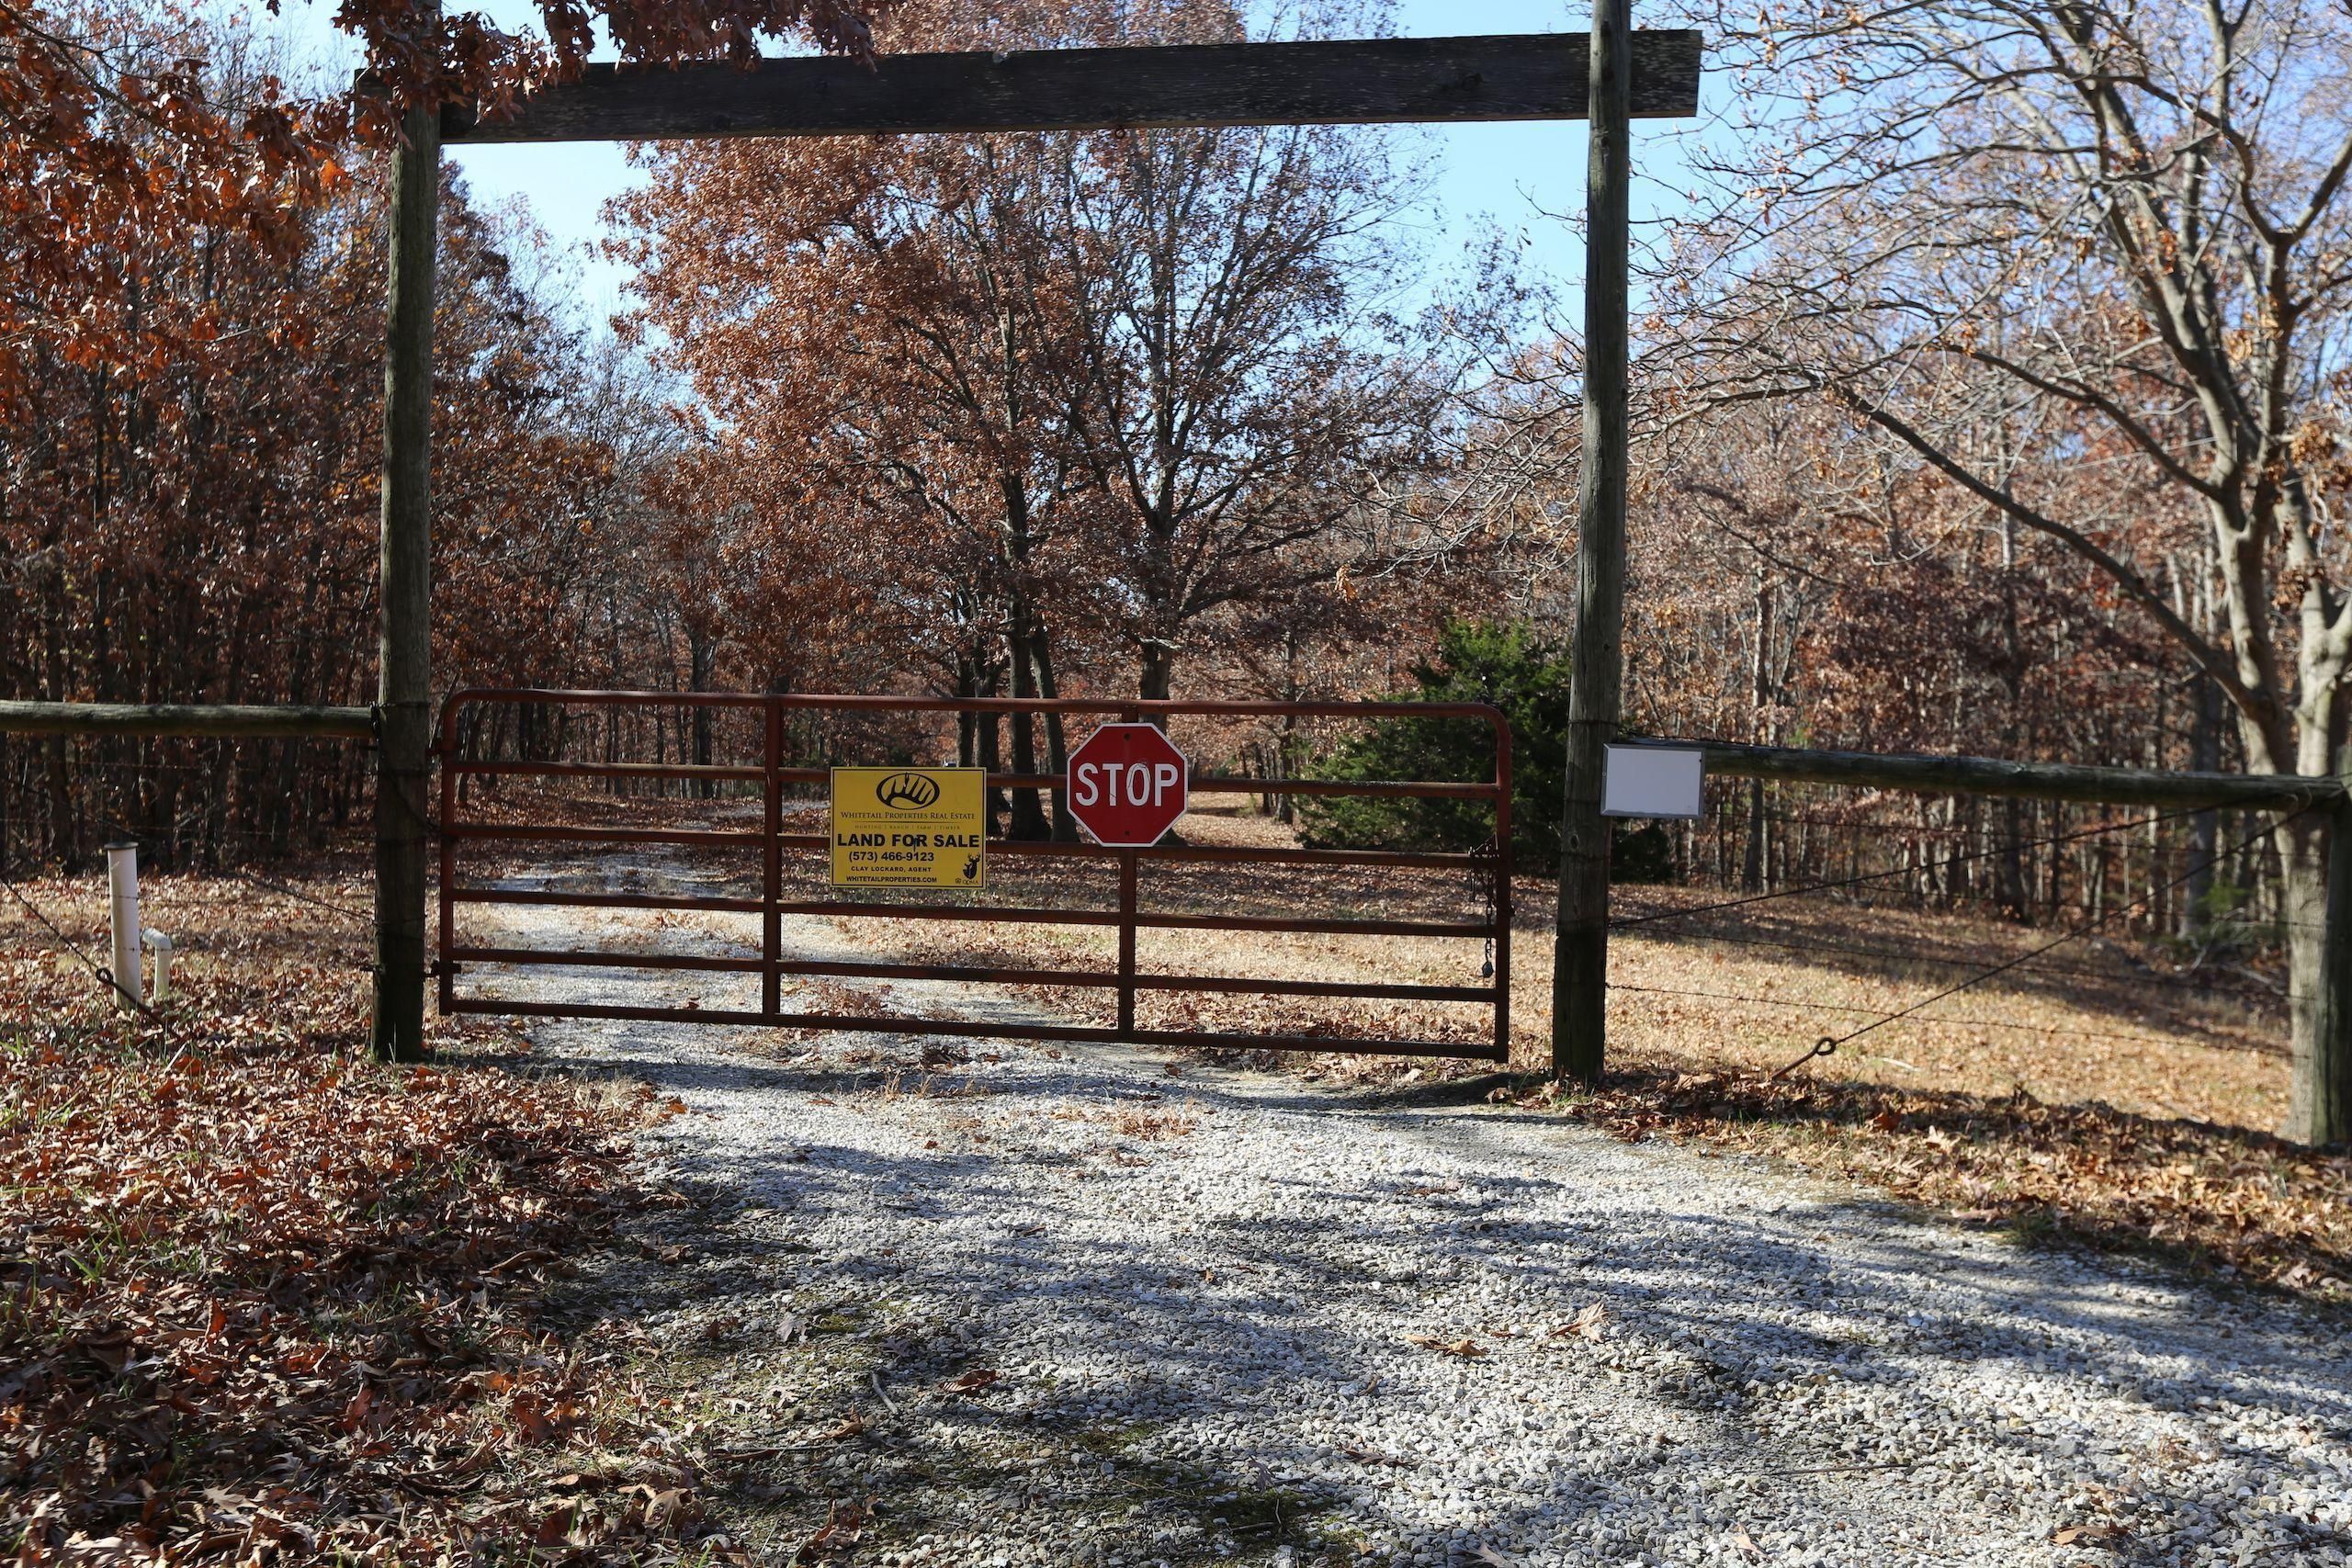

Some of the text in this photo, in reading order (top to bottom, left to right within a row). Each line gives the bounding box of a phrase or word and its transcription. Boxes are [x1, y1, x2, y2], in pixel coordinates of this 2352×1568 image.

[1075, 762, 1179, 807] STOP
[837, 833, 980, 848] LAND FOR SALE
[849, 852, 934, 863] (573) 466-9123
